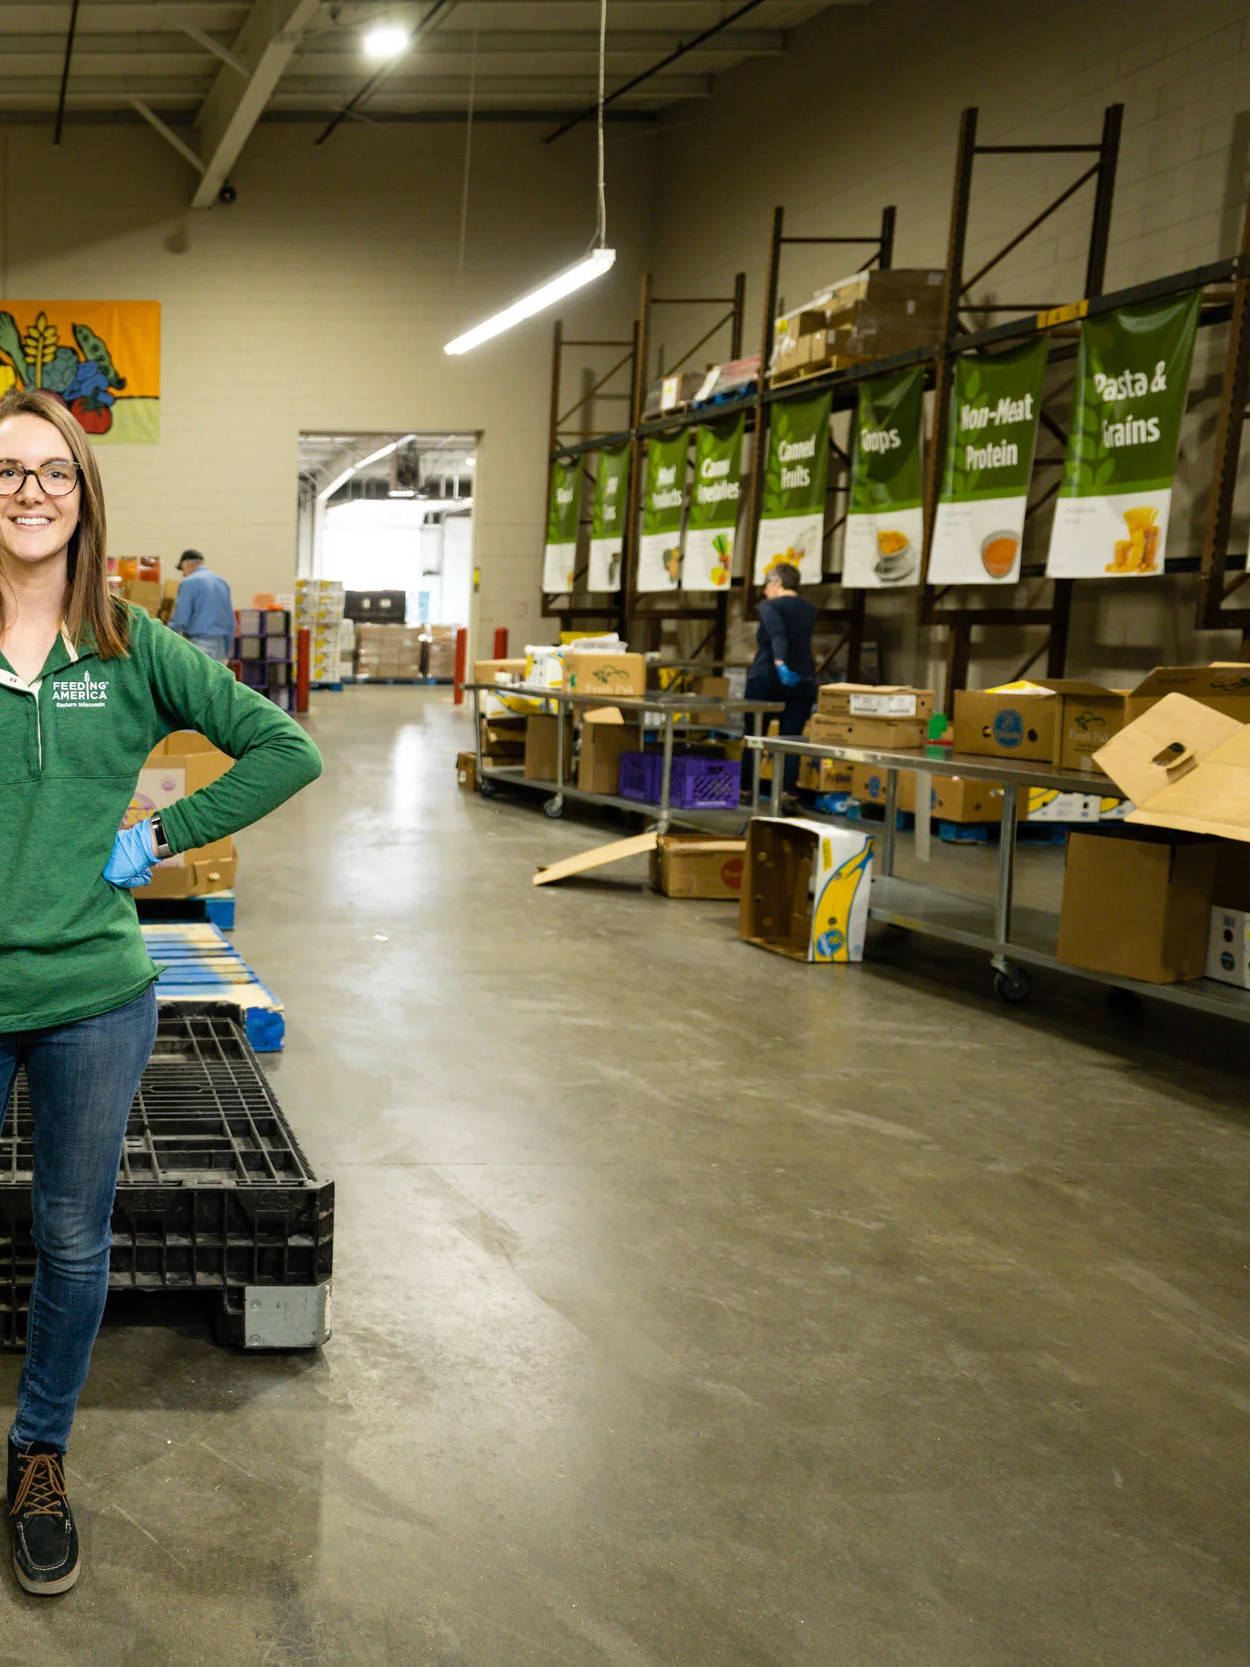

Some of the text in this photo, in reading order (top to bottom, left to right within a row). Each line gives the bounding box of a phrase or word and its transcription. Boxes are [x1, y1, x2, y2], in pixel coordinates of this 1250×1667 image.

[1094, 360, 1167, 402] Pasta &
[961, 393, 1033, 432] Non-Meat
[1103, 414, 1161, 449] Grains
[966, 439, 1018, 472] Protein
[52, 681, 108, 691] FEEDING
[52, 690, 108, 700] AMERICA
